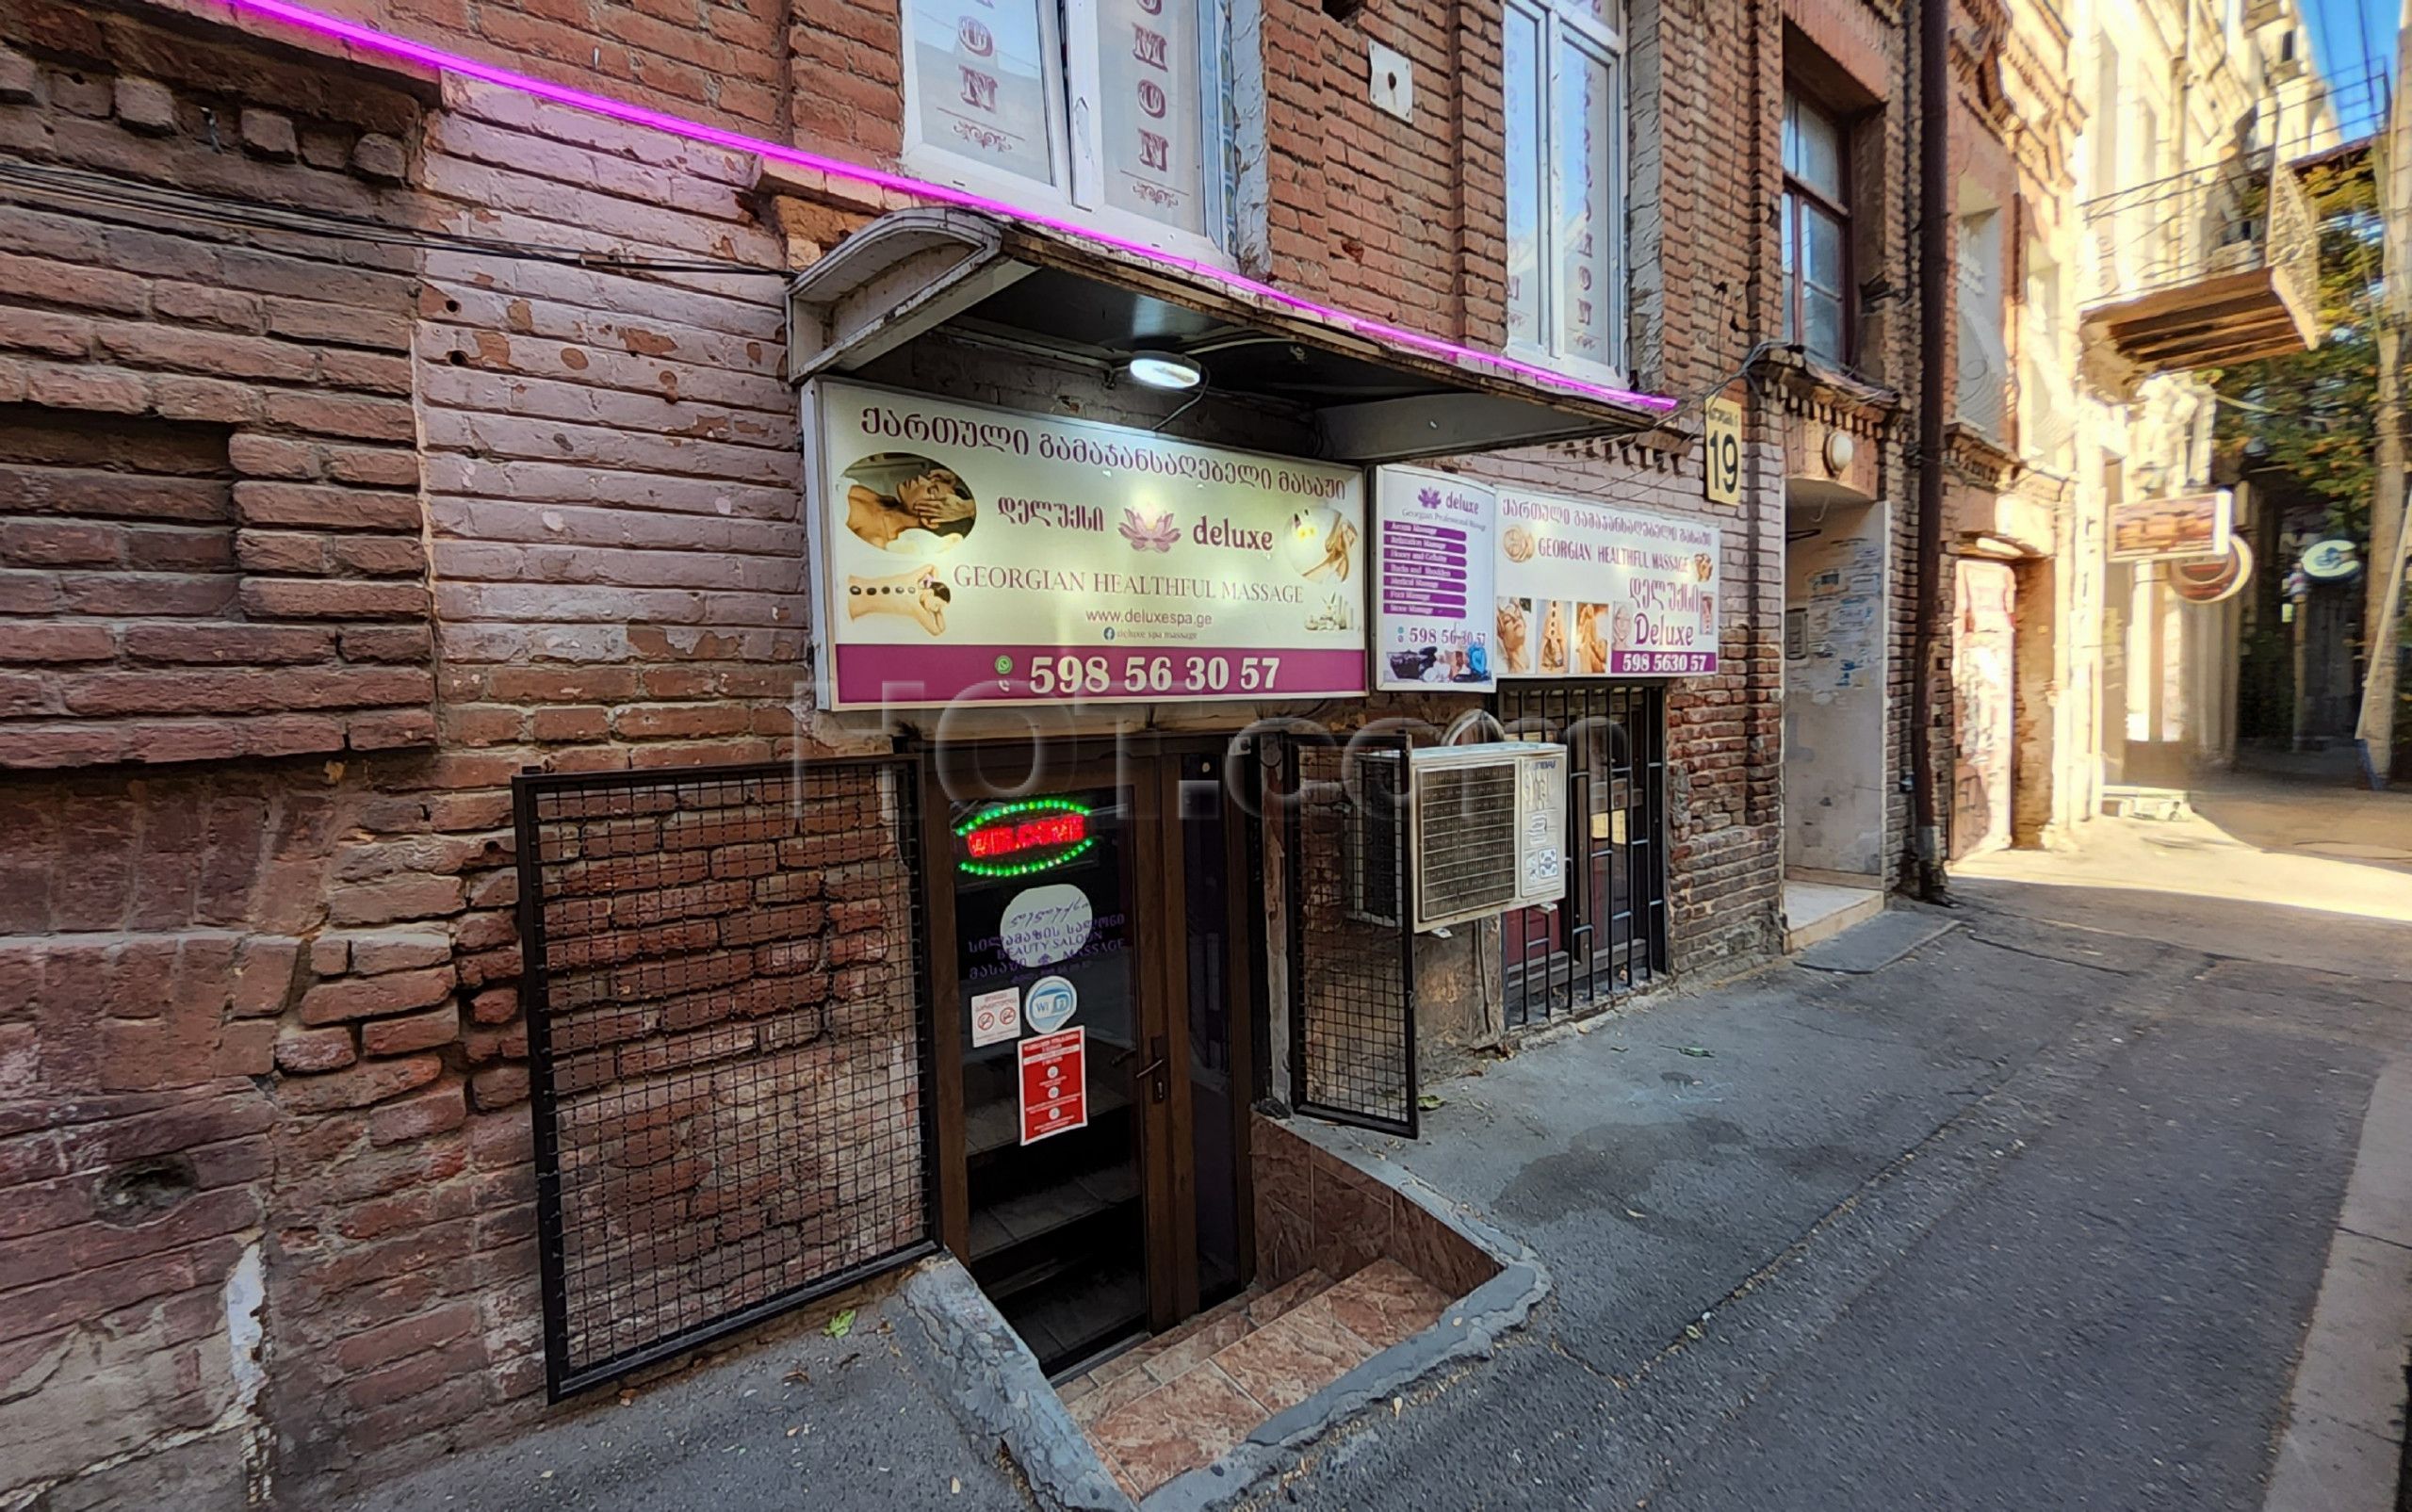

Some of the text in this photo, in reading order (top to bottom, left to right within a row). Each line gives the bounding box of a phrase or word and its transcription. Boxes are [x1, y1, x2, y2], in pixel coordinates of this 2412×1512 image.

[861, 407, 1346, 500] ქართული გამაჯანსაღებელი მასაჟი
[1710, 430, 1738, 493] 19
[998, 496, 1104, 531] დელუქსი
[1445, 491, 1479, 514] deluxe
[1193, 515, 1273, 551] deluxe
[1539, 537, 1689, 573] GEORGIAN HEALTHFUL MASSAGE
[954, 565, 1304, 604] GEORGIAN HEALTHFUL MASSAGE
[1629, 577, 1700, 614] დელუქსი
[1085, 608, 1213, 627] www.deluxespa.ge
[1149, 630, 1163, 640] spa
[1410, 627, 1437, 643] 598
[1634, 612, 1694, 647] Deluxe
[1030, 656, 1280, 694] 598 56 30 57
[1622, 653, 1707, 672] 598 5630 57
[997, 940, 1048, 960] BEAUTY
[1063, 939, 1125, 960] MASSAGE
